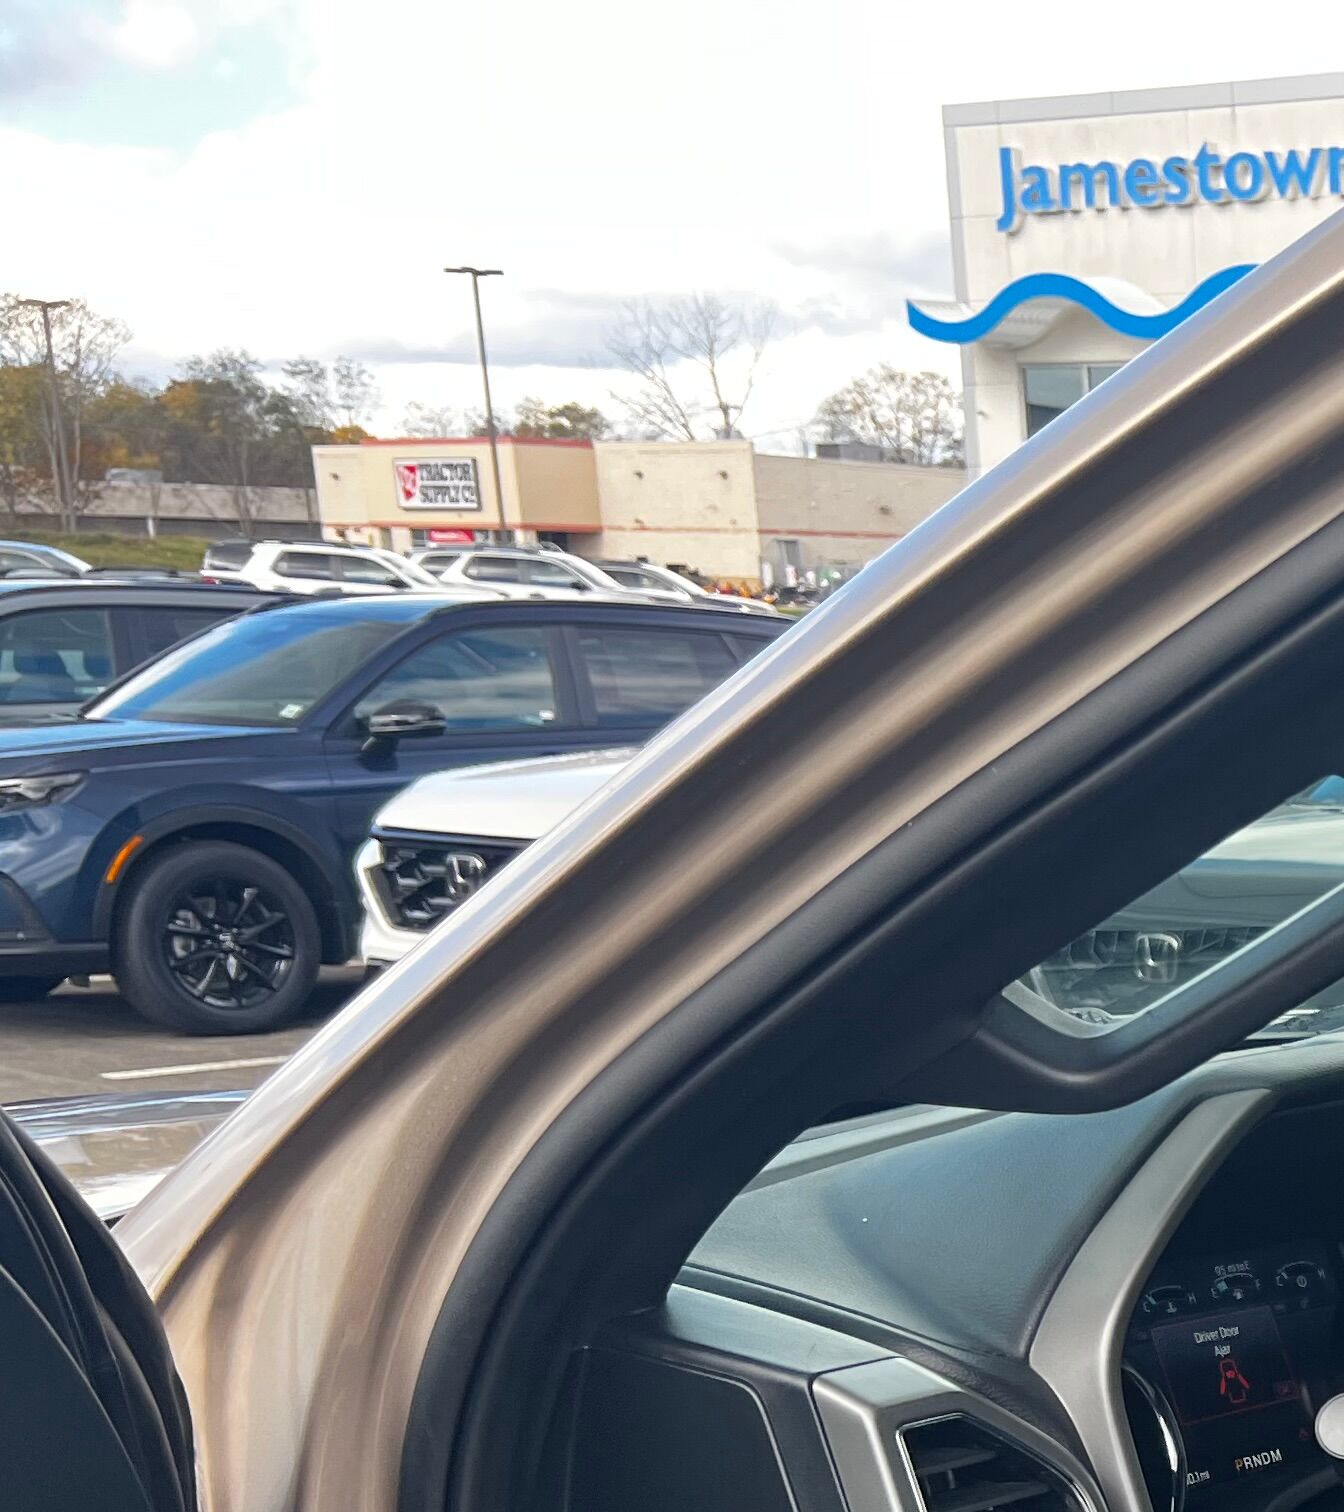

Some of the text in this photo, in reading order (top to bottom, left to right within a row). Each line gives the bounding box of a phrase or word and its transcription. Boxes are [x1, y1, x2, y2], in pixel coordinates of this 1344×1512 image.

[1193, 1326, 1240, 1344] Driver Door
[1214, 1345, 1231, 1358] Ajar
